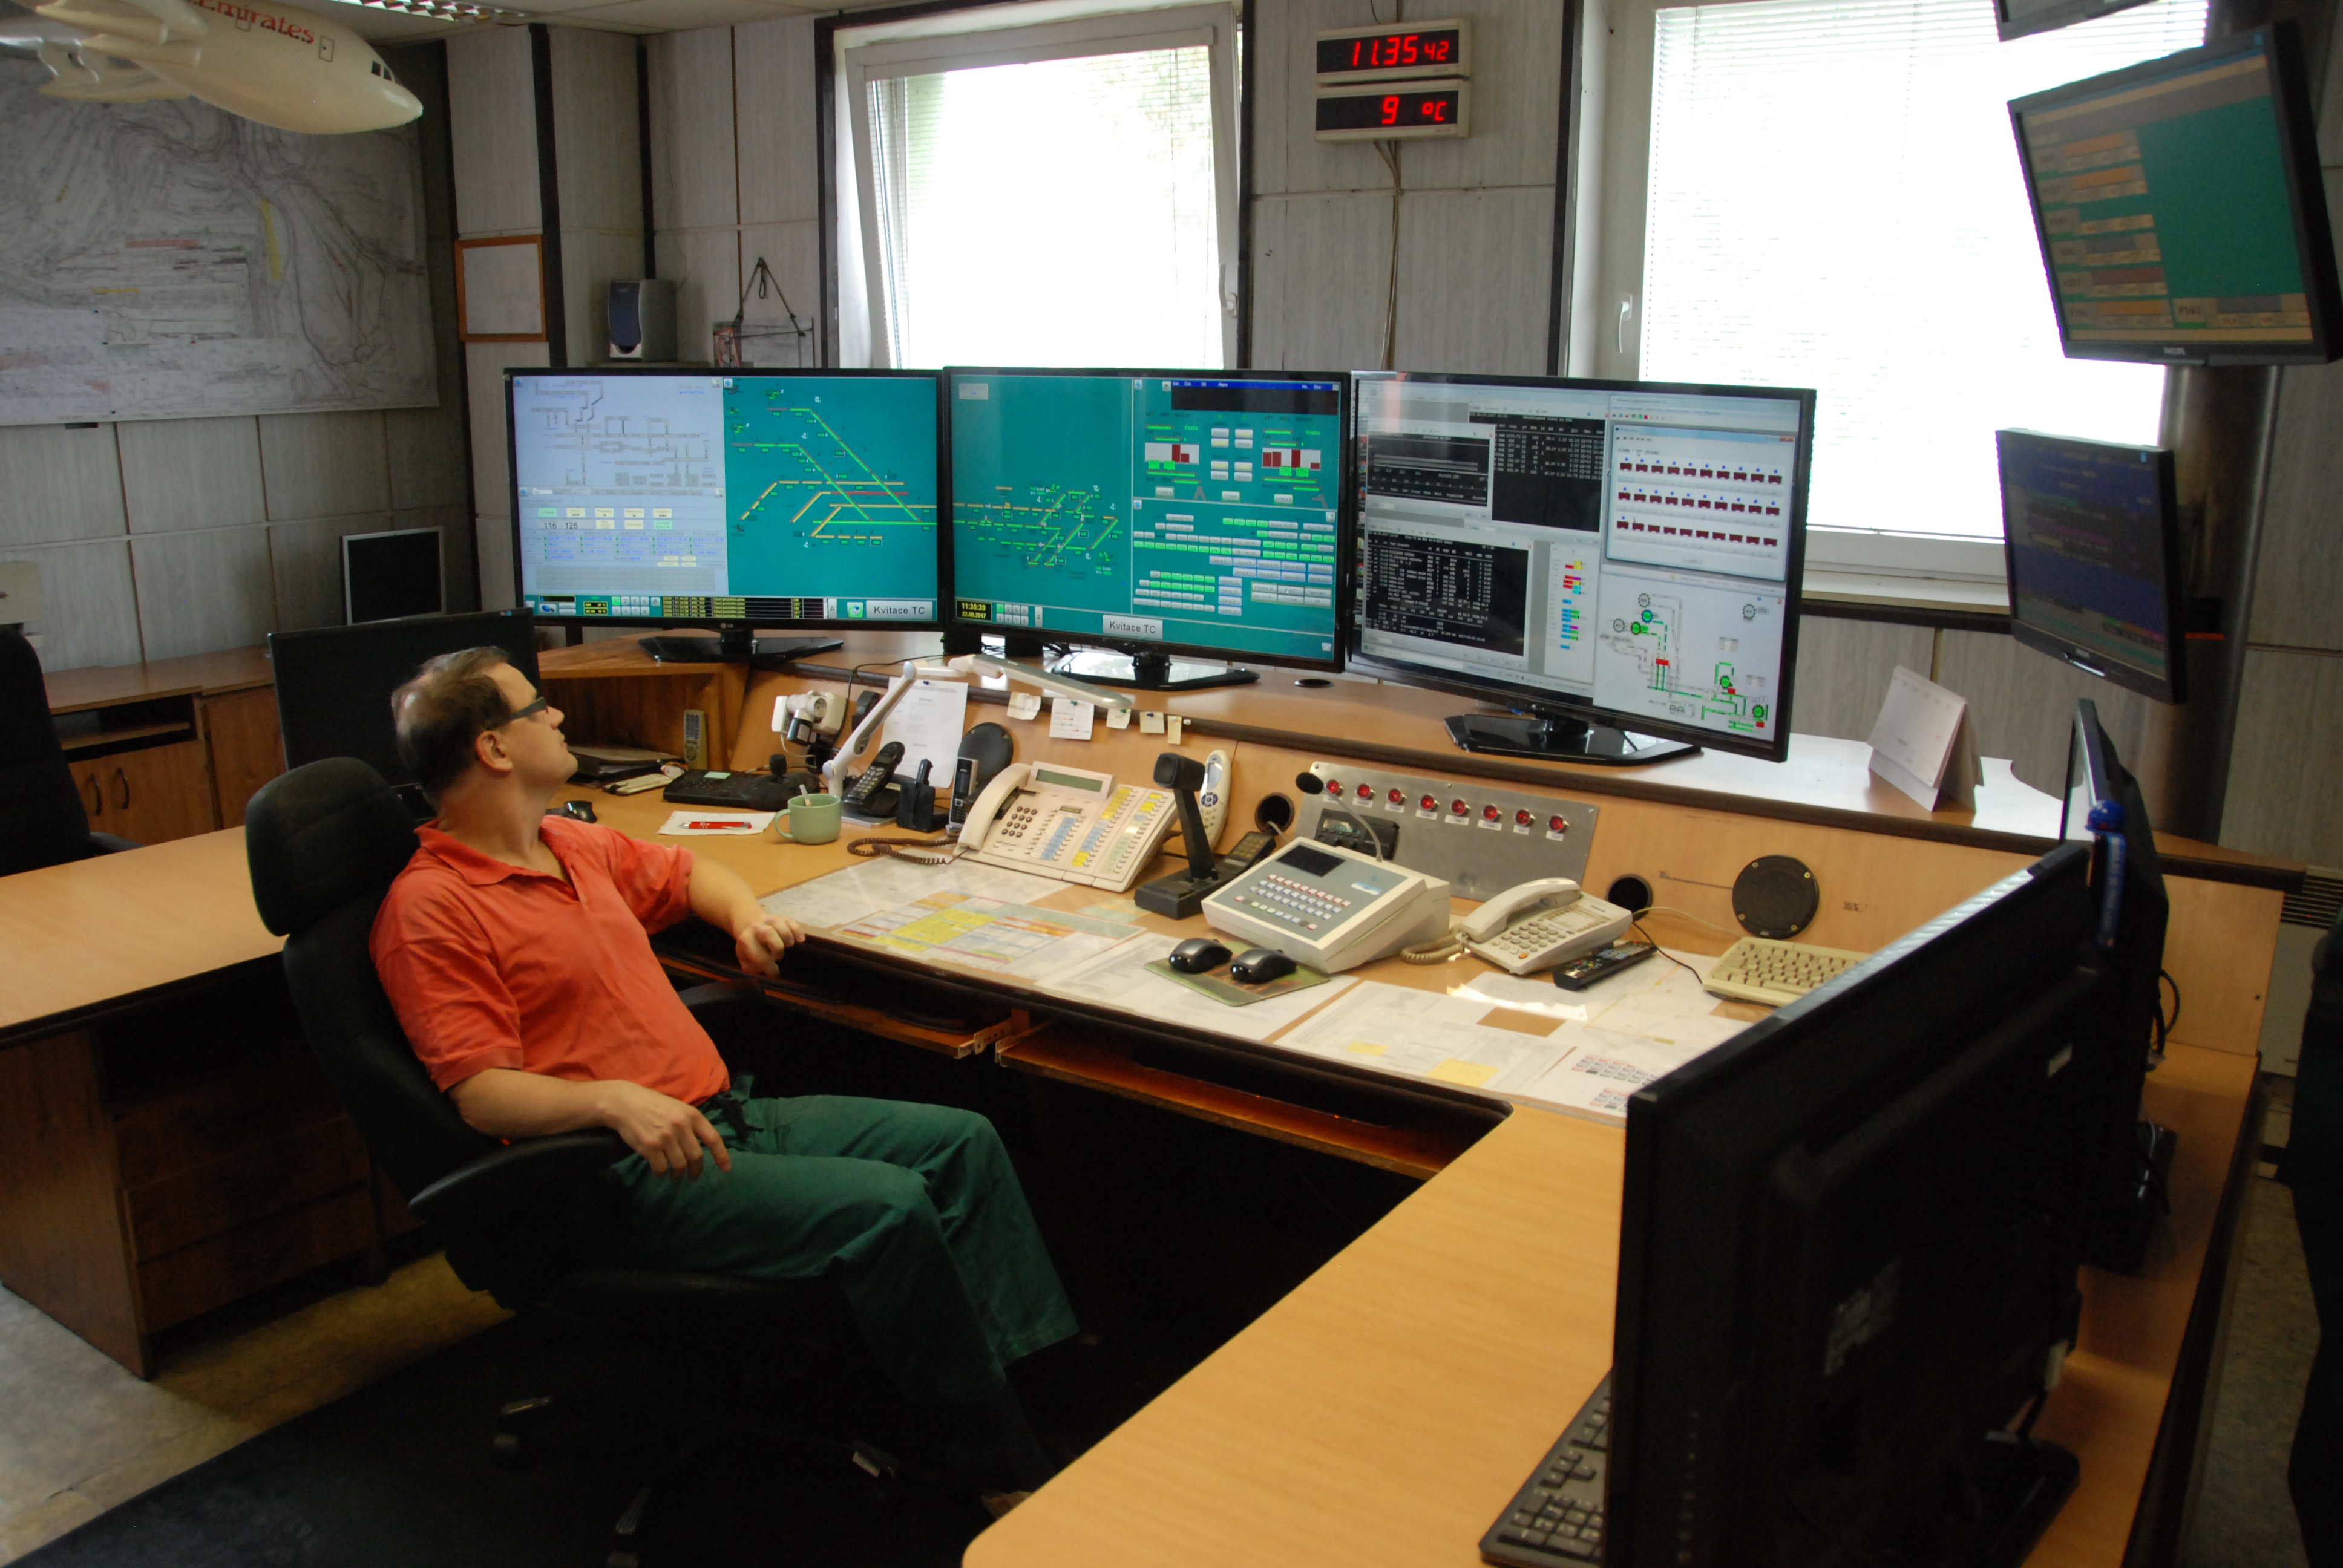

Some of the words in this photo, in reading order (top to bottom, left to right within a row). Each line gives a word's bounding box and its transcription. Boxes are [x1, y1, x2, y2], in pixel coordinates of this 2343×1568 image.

[1424, 40, 1449, 61] 42
[1381, 95, 1400, 125] 9
[874, 606, 908, 615] Kvitace
[912, 606, 925, 615] TC
[962, 611, 986, 619] 22.09.2017
[1110, 621, 1141, 632] Kvitace
[1144, 624, 1156, 633] TC
